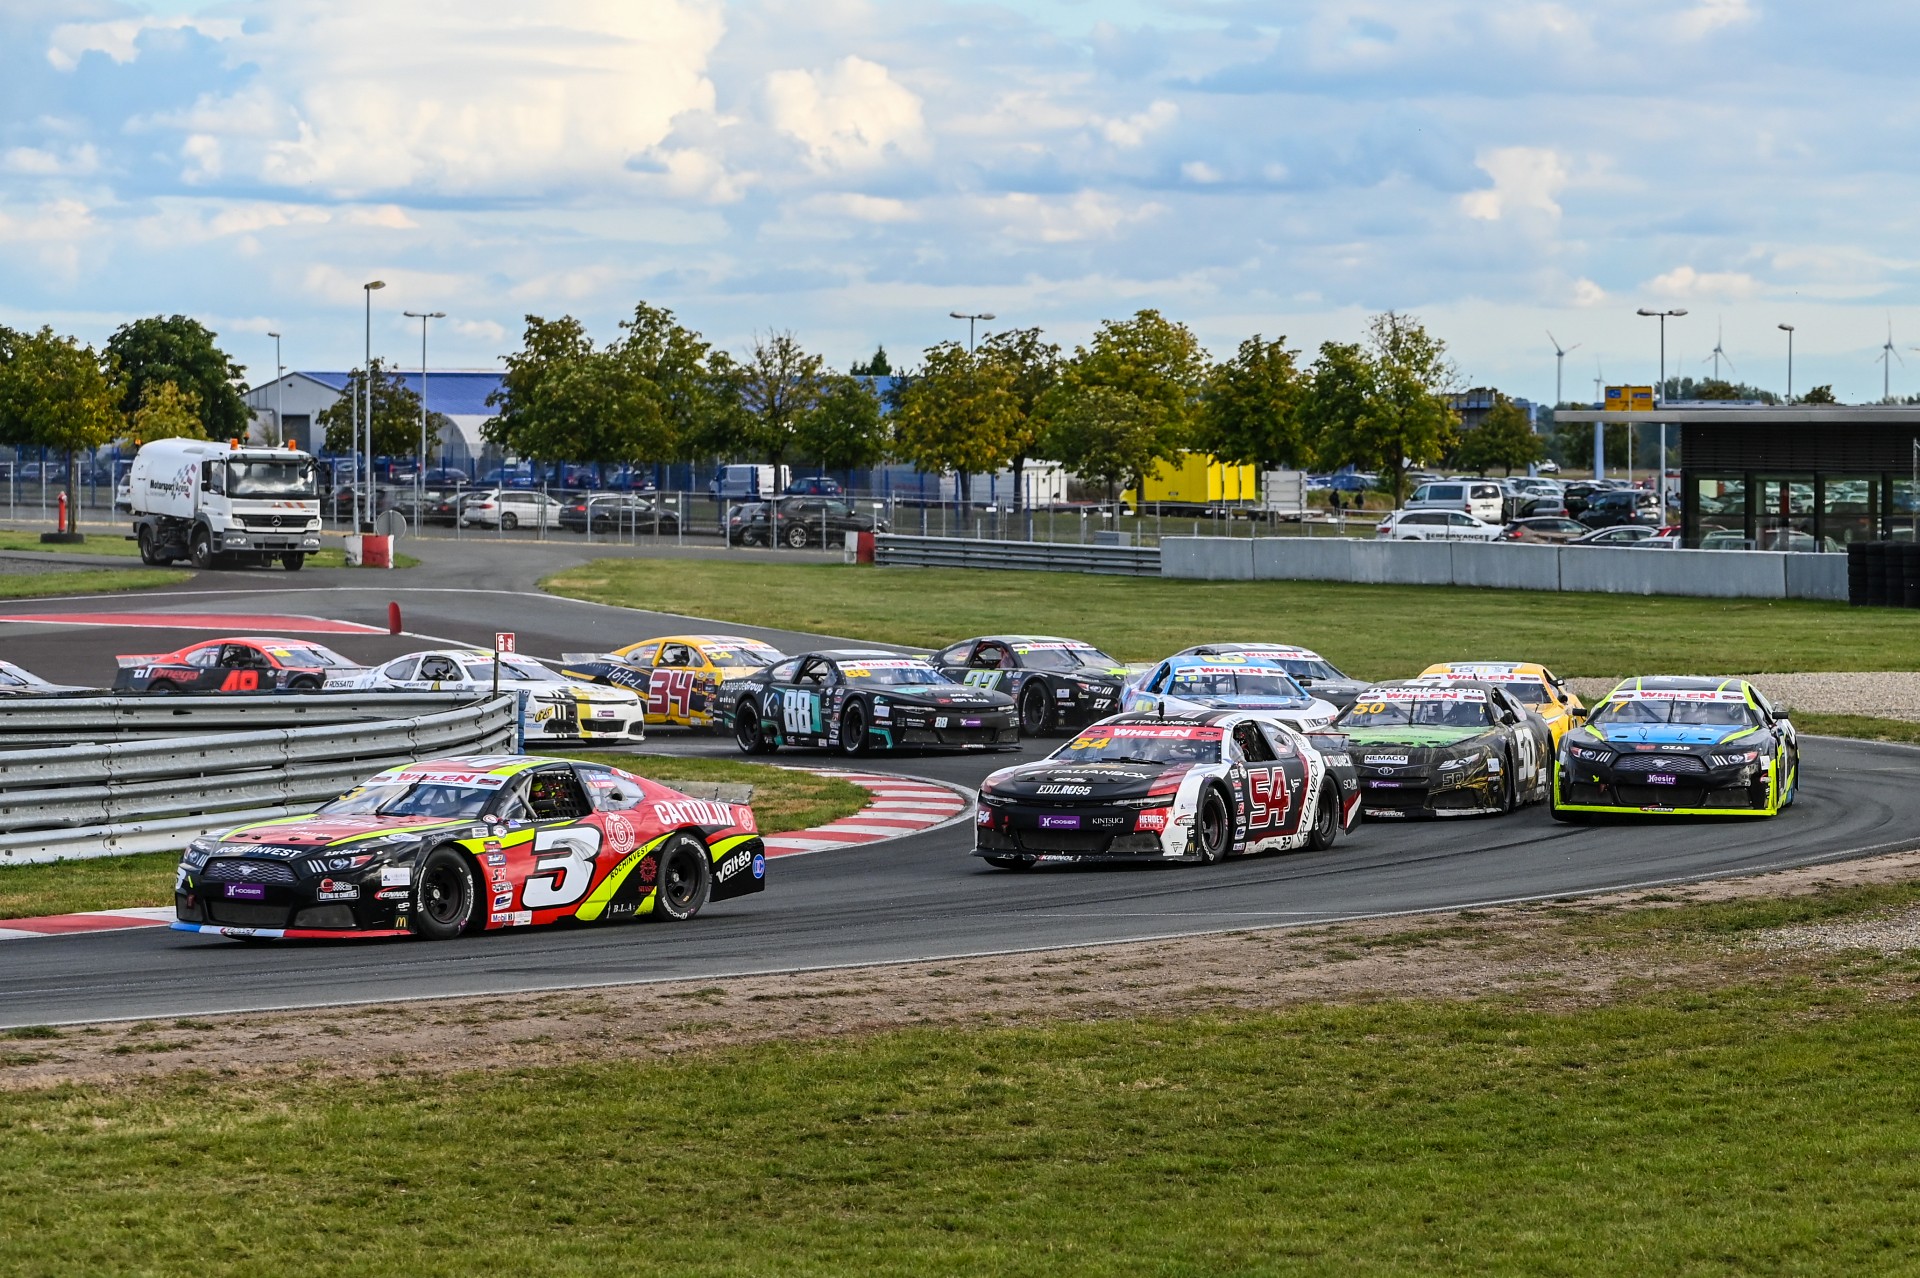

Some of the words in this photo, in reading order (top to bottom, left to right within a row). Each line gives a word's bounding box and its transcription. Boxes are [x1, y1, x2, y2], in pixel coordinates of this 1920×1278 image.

[151, 669, 199, 682] Omega
[607, 663, 643, 692] Toffel
[844, 669, 871, 678] 88
[329, 680, 354, 688] ROSSATO
[648, 669, 695, 717] 34
[1640, 691, 1716, 699] WHELEN
[1093, 698, 1111, 709] 27
[1352, 702, 1386, 715] 50
[1613, 701, 1630, 712] 7
[783, 689, 812, 734] 88
[935, 717, 948, 728] 88
[1114, 729, 1192, 737] WHELEN
[1070, 738, 1111, 750] 54
[1515, 728, 1535, 781] 50
[396, 773, 475, 782] WHELEN
[1046, 769, 1152, 780] ITALIANBOX
[1443, 771, 1464, 787] 50
[1247, 767, 1291, 829] 54
[978, 810, 990, 823] 54
[1092, 817, 1124, 825] KINTSUGI
[1139, 815, 1164, 824] HEROES
[215, 845, 302, 858] ROCHINVEST
[521, 827, 601, 909] 3
[610, 844, 649, 880] ROCHINVEST
[377, 890, 410, 898] KENNOL
